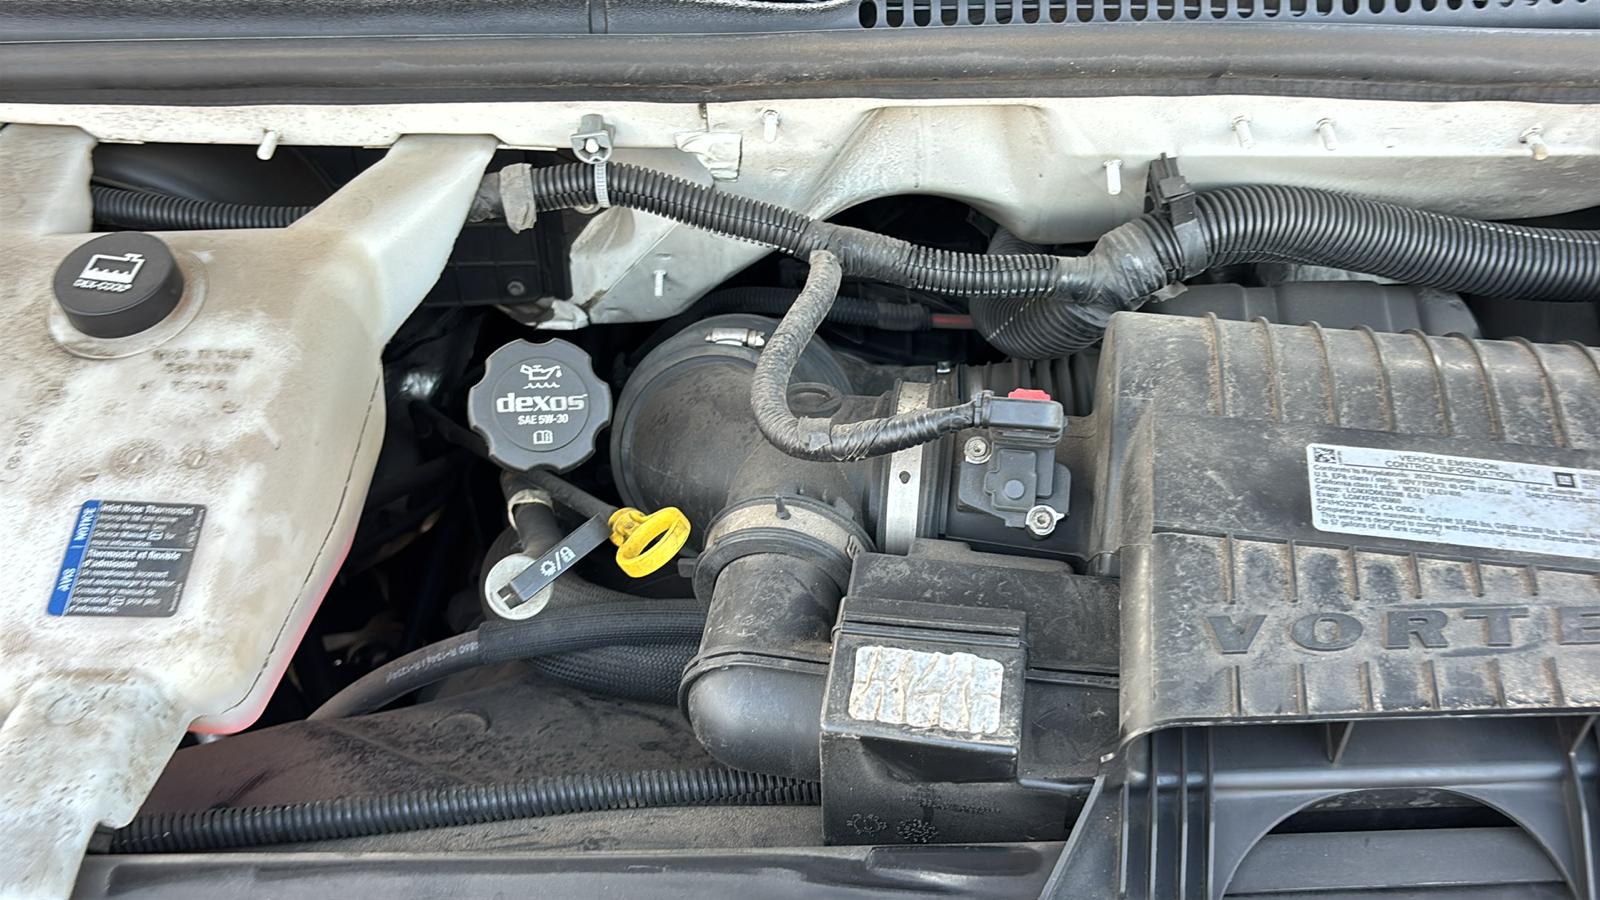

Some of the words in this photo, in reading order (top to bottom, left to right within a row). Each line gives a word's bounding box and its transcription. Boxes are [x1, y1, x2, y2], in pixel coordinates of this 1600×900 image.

[496, 392, 586, 413] dexos
[518, 415, 537, 425] SAE
[538, 414, 569, 424] 5W-30
[1385, 461, 1437, 471] CONTROL
[1438, 465, 1514, 479] INFORMATION
[1398, 455, 1445, 464] VEHICLE
[1447, 458, 1499, 470] EMISSION
[74, 507, 96, 541] NOTICE
[58, 568, 76, 592] AVIS
